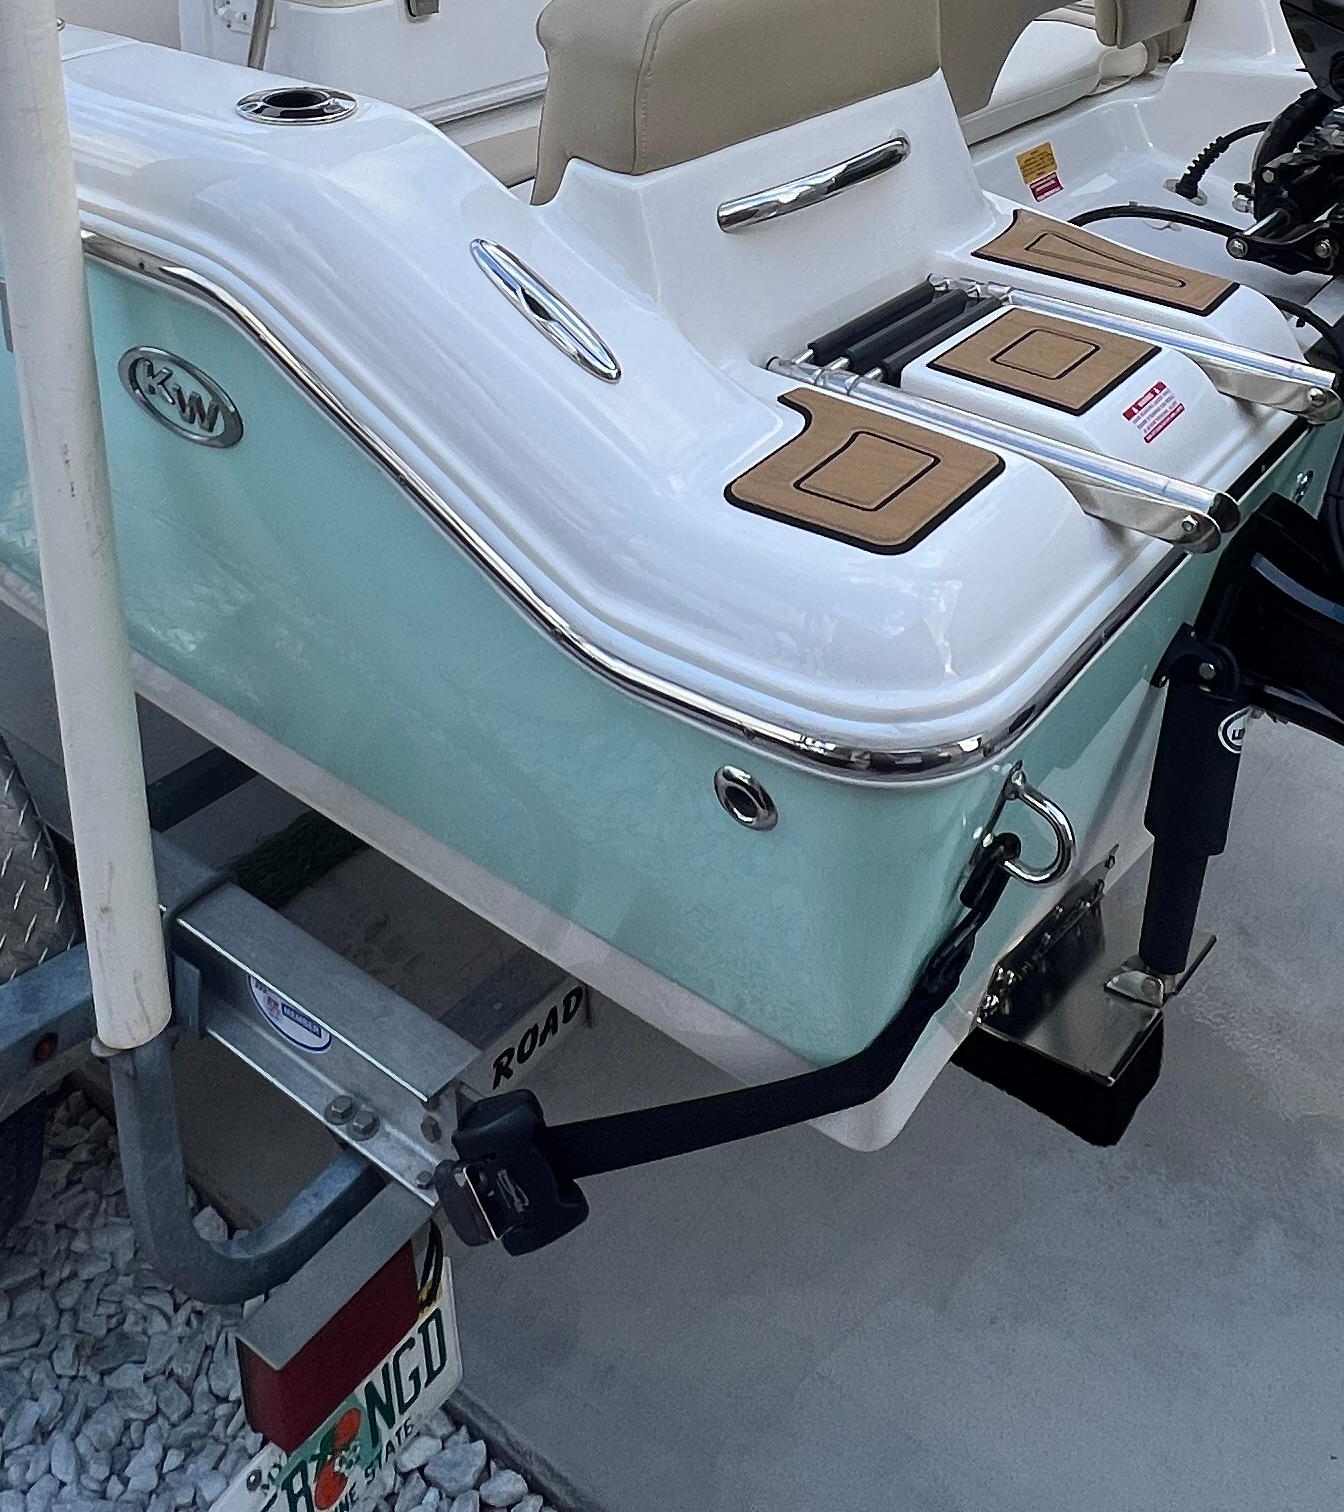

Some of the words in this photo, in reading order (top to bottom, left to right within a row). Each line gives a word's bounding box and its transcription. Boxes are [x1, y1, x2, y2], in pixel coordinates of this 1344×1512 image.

[136, 357, 220, 433] KW
[492, 986, 584, 1090] ROAD
[363, 1306, 448, 1450] NGD
